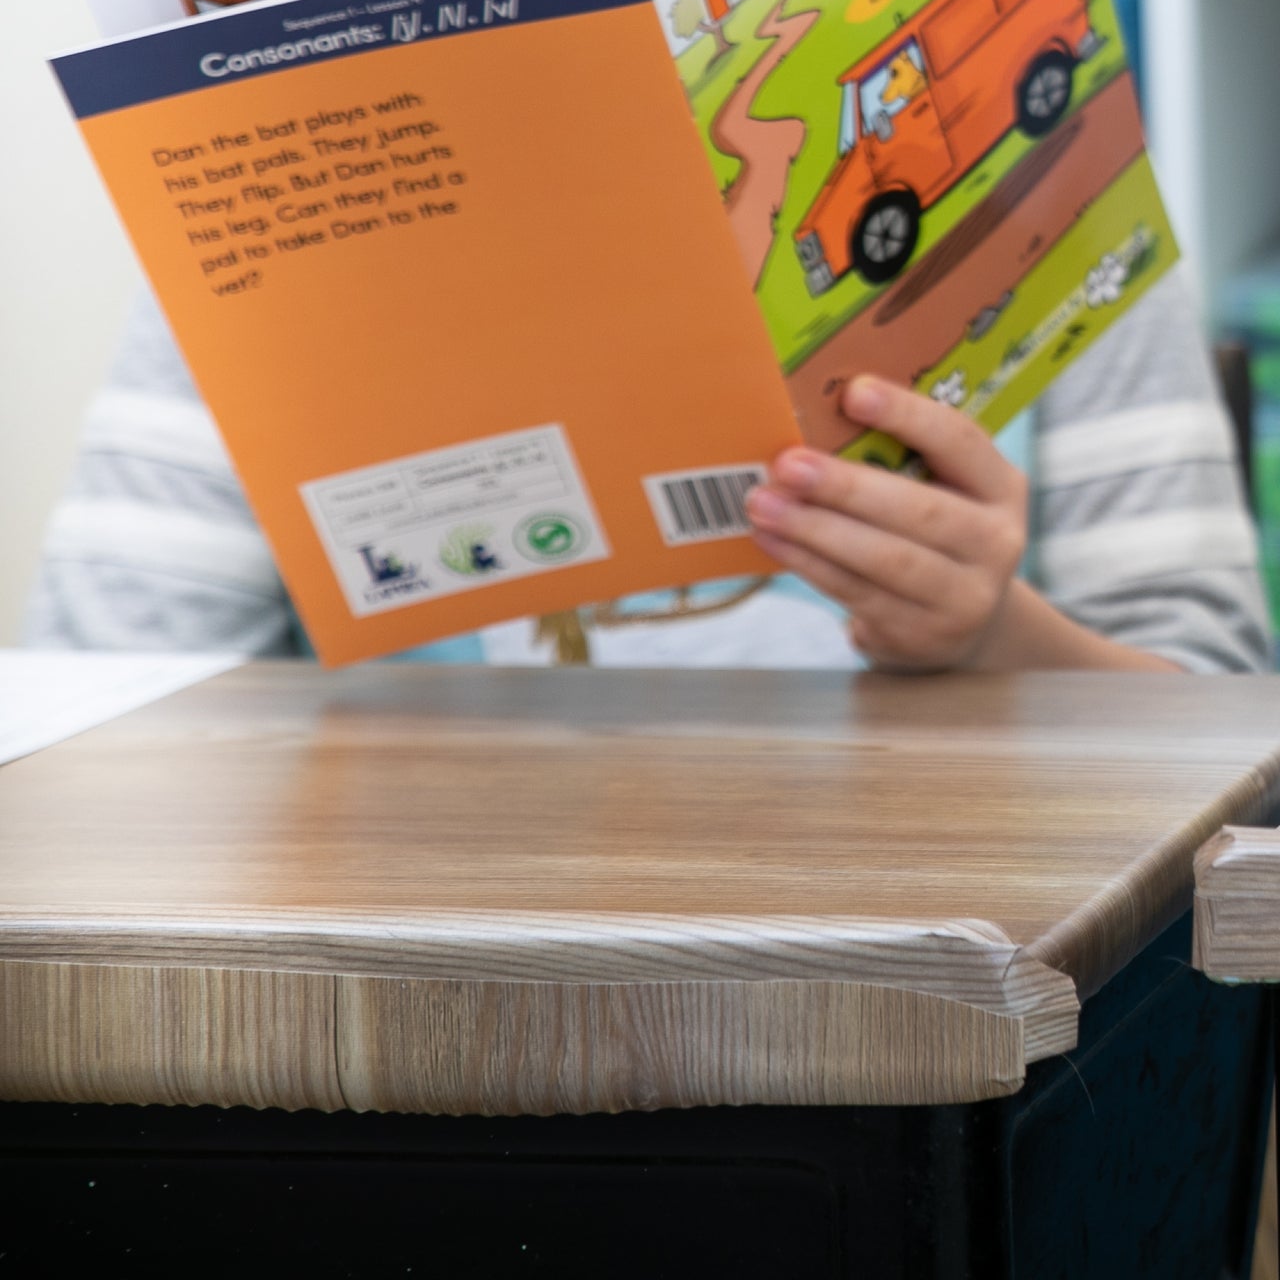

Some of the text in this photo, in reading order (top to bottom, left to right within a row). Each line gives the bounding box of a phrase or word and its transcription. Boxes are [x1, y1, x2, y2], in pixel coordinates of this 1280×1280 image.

[199, 25, 383, 78] Consonants:
[152, 92, 422, 167] Dan the bat plays with
[163, 120, 441, 193] his bat pals. They jump.
[177, 195, 237, 217] They
[288, 170, 331, 192] But
[333, 159, 386, 181] Dan
[389, 145, 454, 169] hurts
[186, 227, 225, 245] his
[275, 200, 330, 224] Can
[333, 188, 388, 209] they
[391, 172, 444, 196] find
[447, 171, 466, 186] a
[200, 201, 458, 276] pal to take Dan to the
[213, 269, 263, 297] vet?
